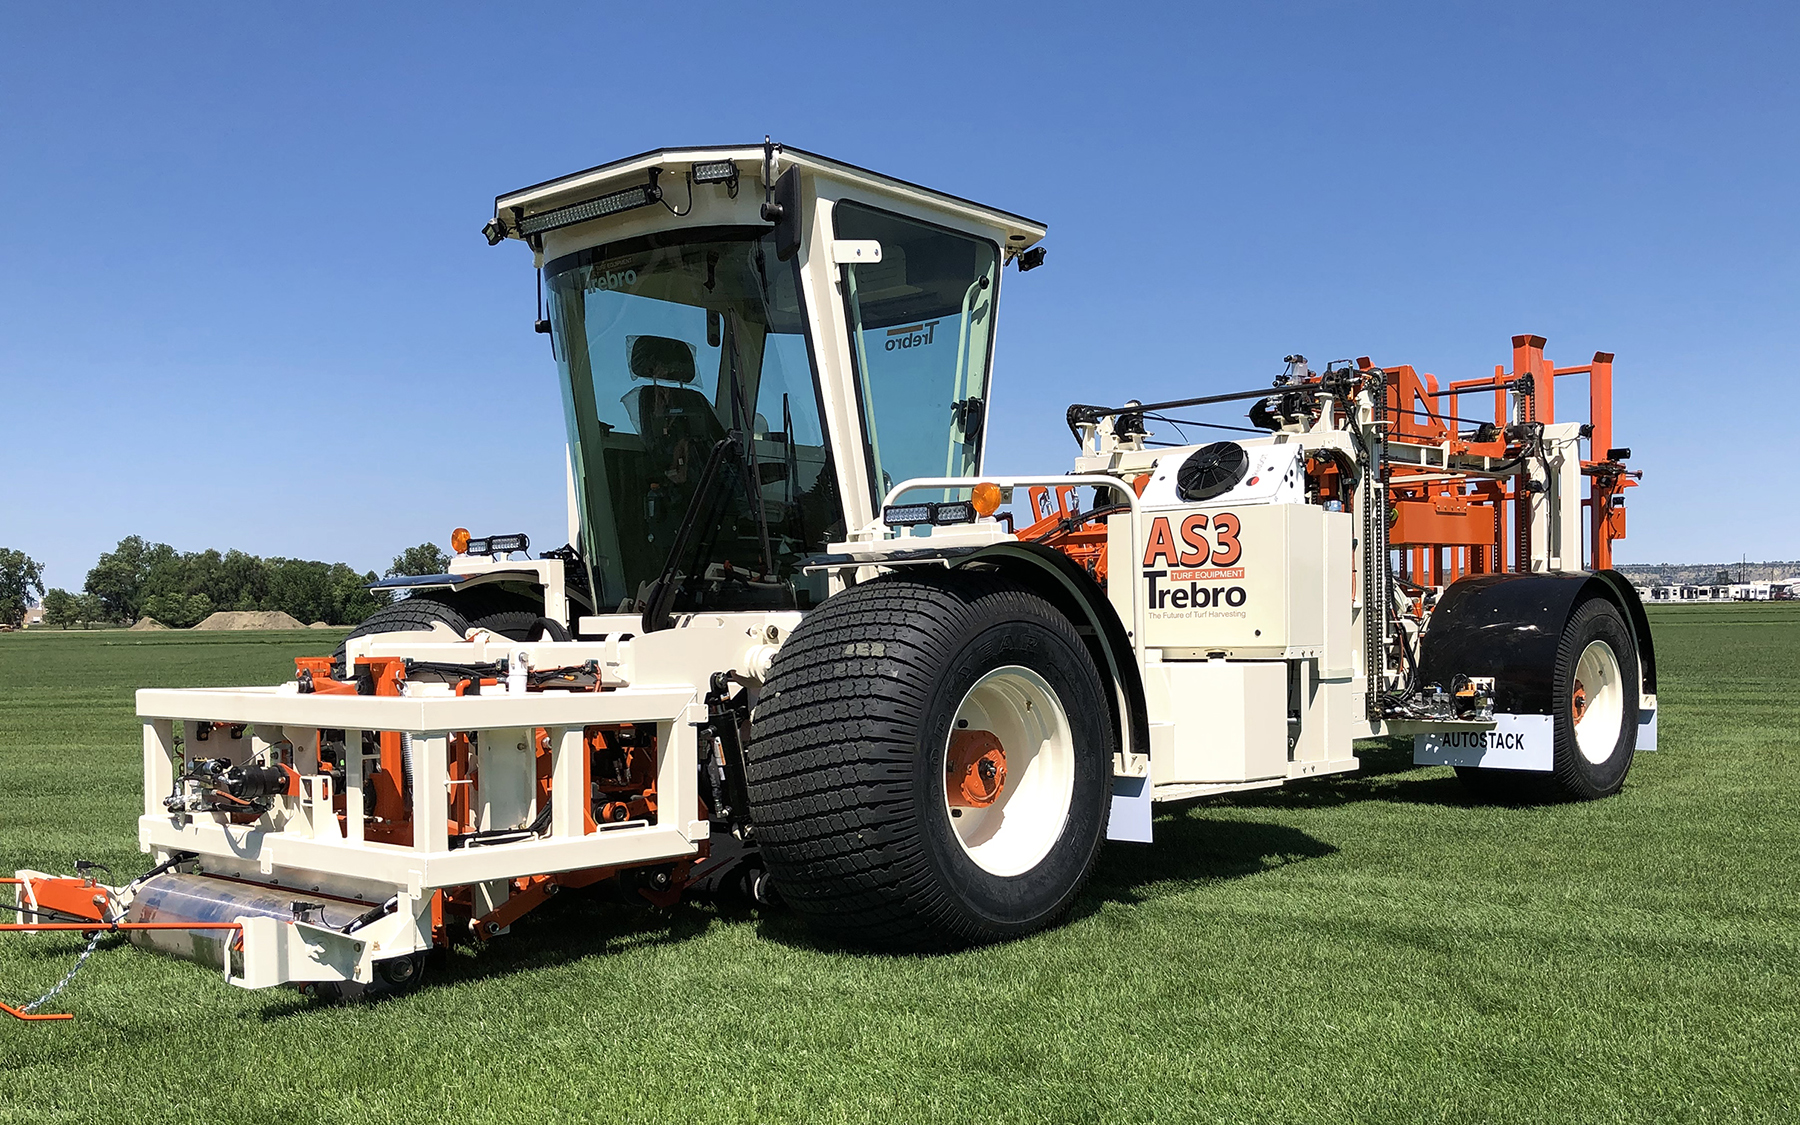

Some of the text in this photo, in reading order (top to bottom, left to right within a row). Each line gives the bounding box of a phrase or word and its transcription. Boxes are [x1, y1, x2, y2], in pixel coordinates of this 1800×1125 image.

[579, 263, 637, 294] Trebro
[1142, 512, 1242, 568] AS3
[1195, 570, 1243, 579] EQUIPMENT
[1142, 570, 1246, 609] Trebro
[1162, 611, 1184, 619] Future
[1193, 610, 1207, 618] Turf
[1208, 610, 1247, 619] Harvesting
[1442, 731, 1525, 750] AUTOSTACK
